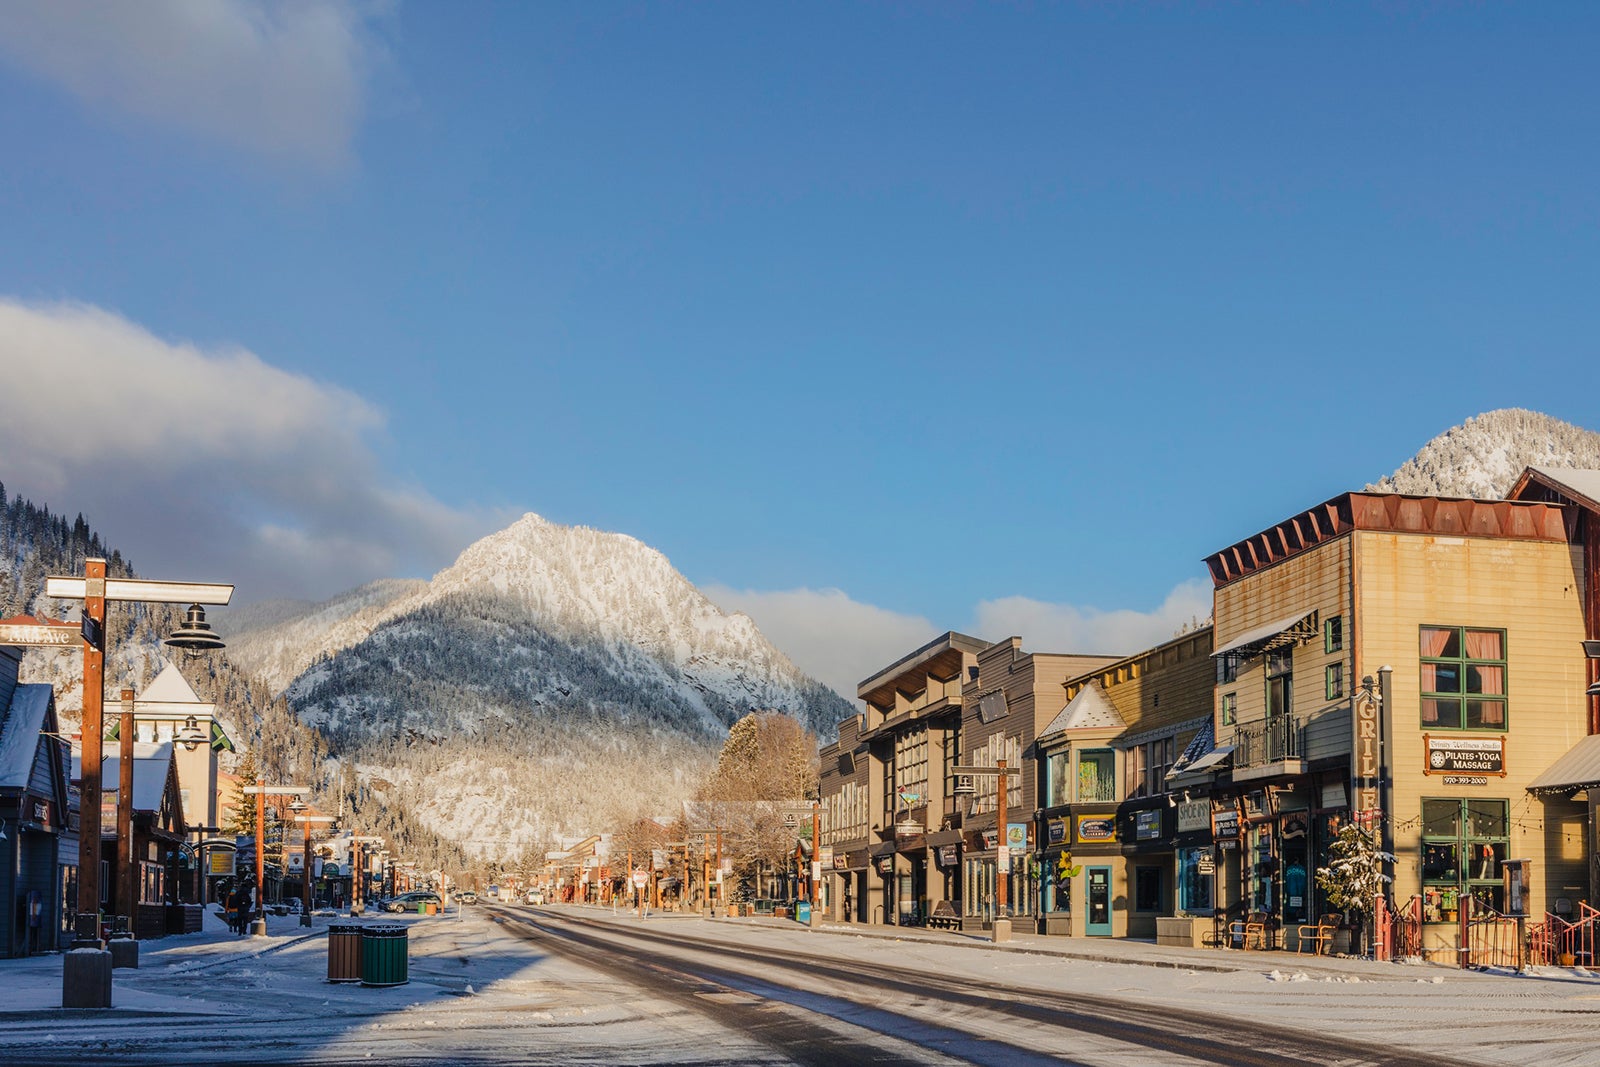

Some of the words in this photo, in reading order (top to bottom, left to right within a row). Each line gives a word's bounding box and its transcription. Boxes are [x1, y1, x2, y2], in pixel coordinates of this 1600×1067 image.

[44, 628, 70, 643] Ave
[1359, 700, 1376, 811] GRILLE
[1445, 751, 1474, 760] PILATES
[1478, 752, 1501, 761] YOGA
[1453, 761, 1492, 769] MASSAGE
[1180, 803, 1197, 821] SHOE
[1198, 801, 1209, 818] INN
